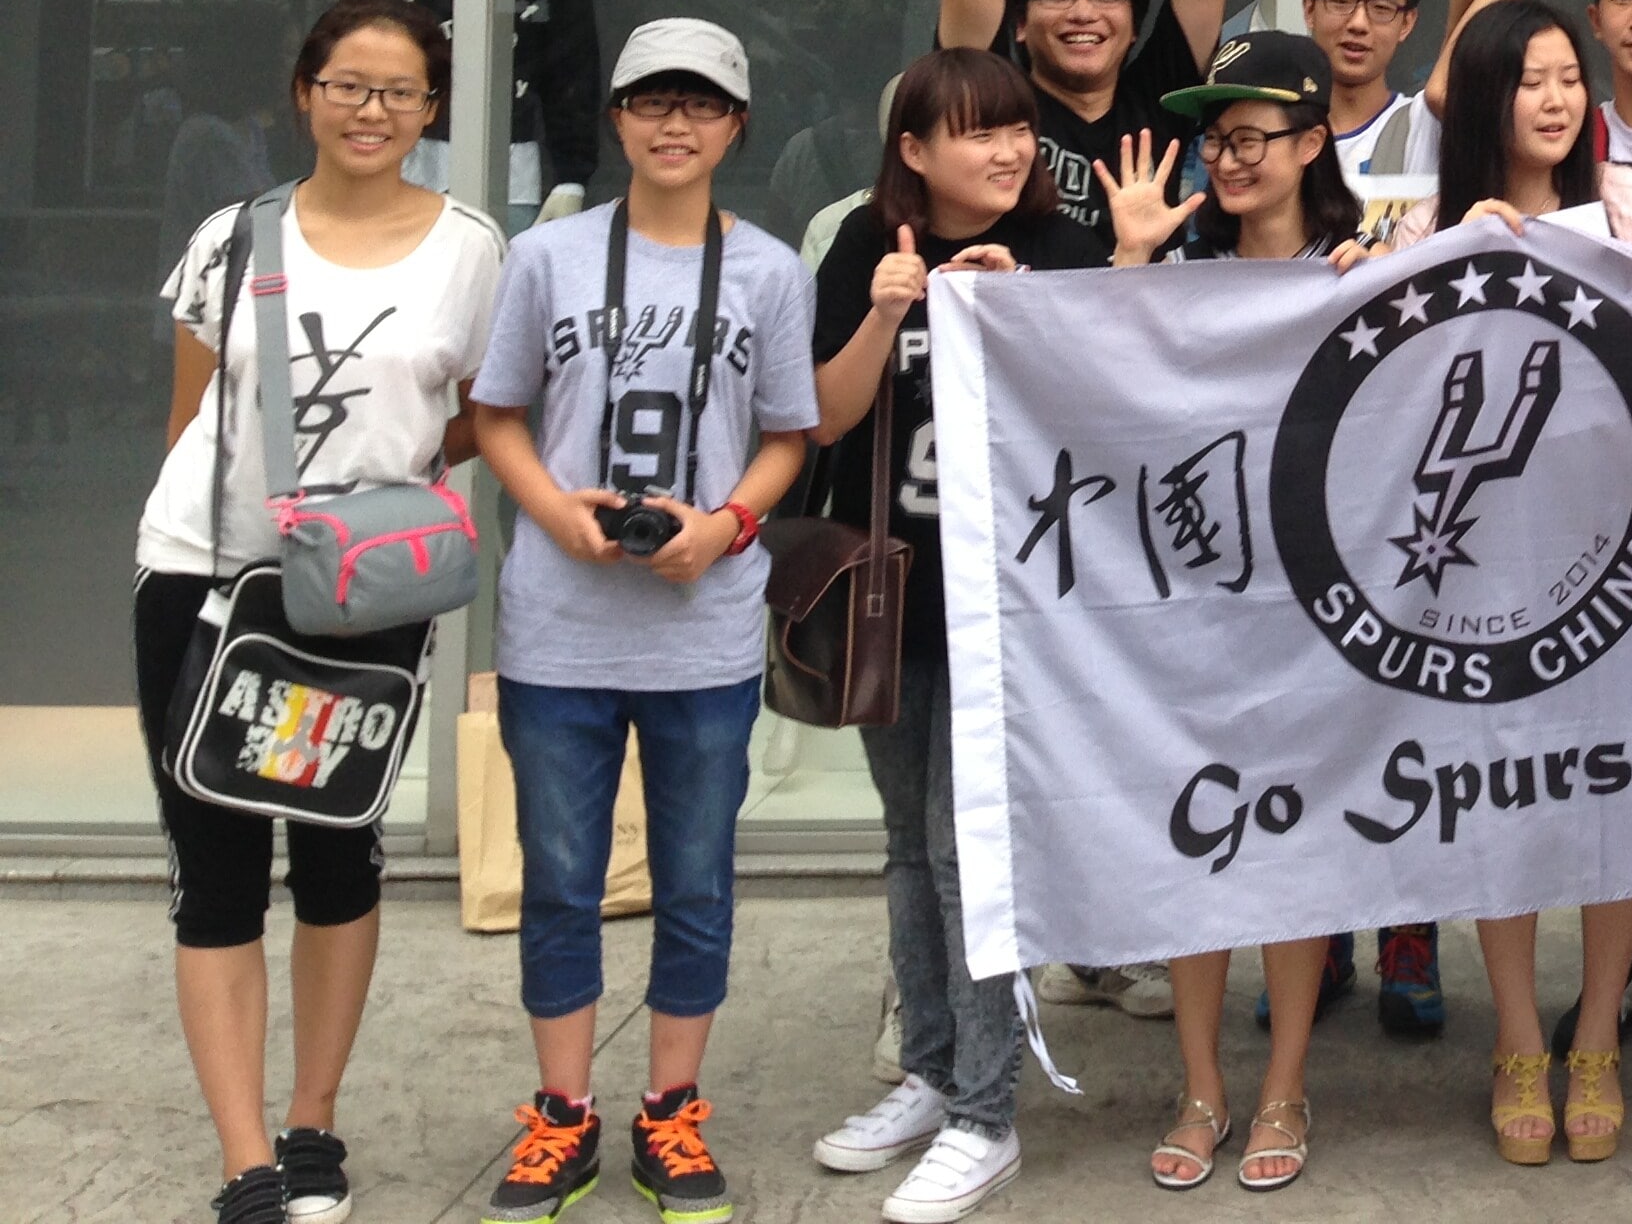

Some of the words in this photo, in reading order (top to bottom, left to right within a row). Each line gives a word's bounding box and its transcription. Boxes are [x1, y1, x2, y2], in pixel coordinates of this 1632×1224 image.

[610, 389, 683, 493] 9
[1419, 607, 1531, 636] SINCE
[1548, 533, 1612, 606] 2014
[1313, 582, 1494, 699] SPURS
[217, 669, 397, 751] ASTRO
[1169, 763, 1303, 875] Go
[1344, 739, 1632, 844] Spurs
